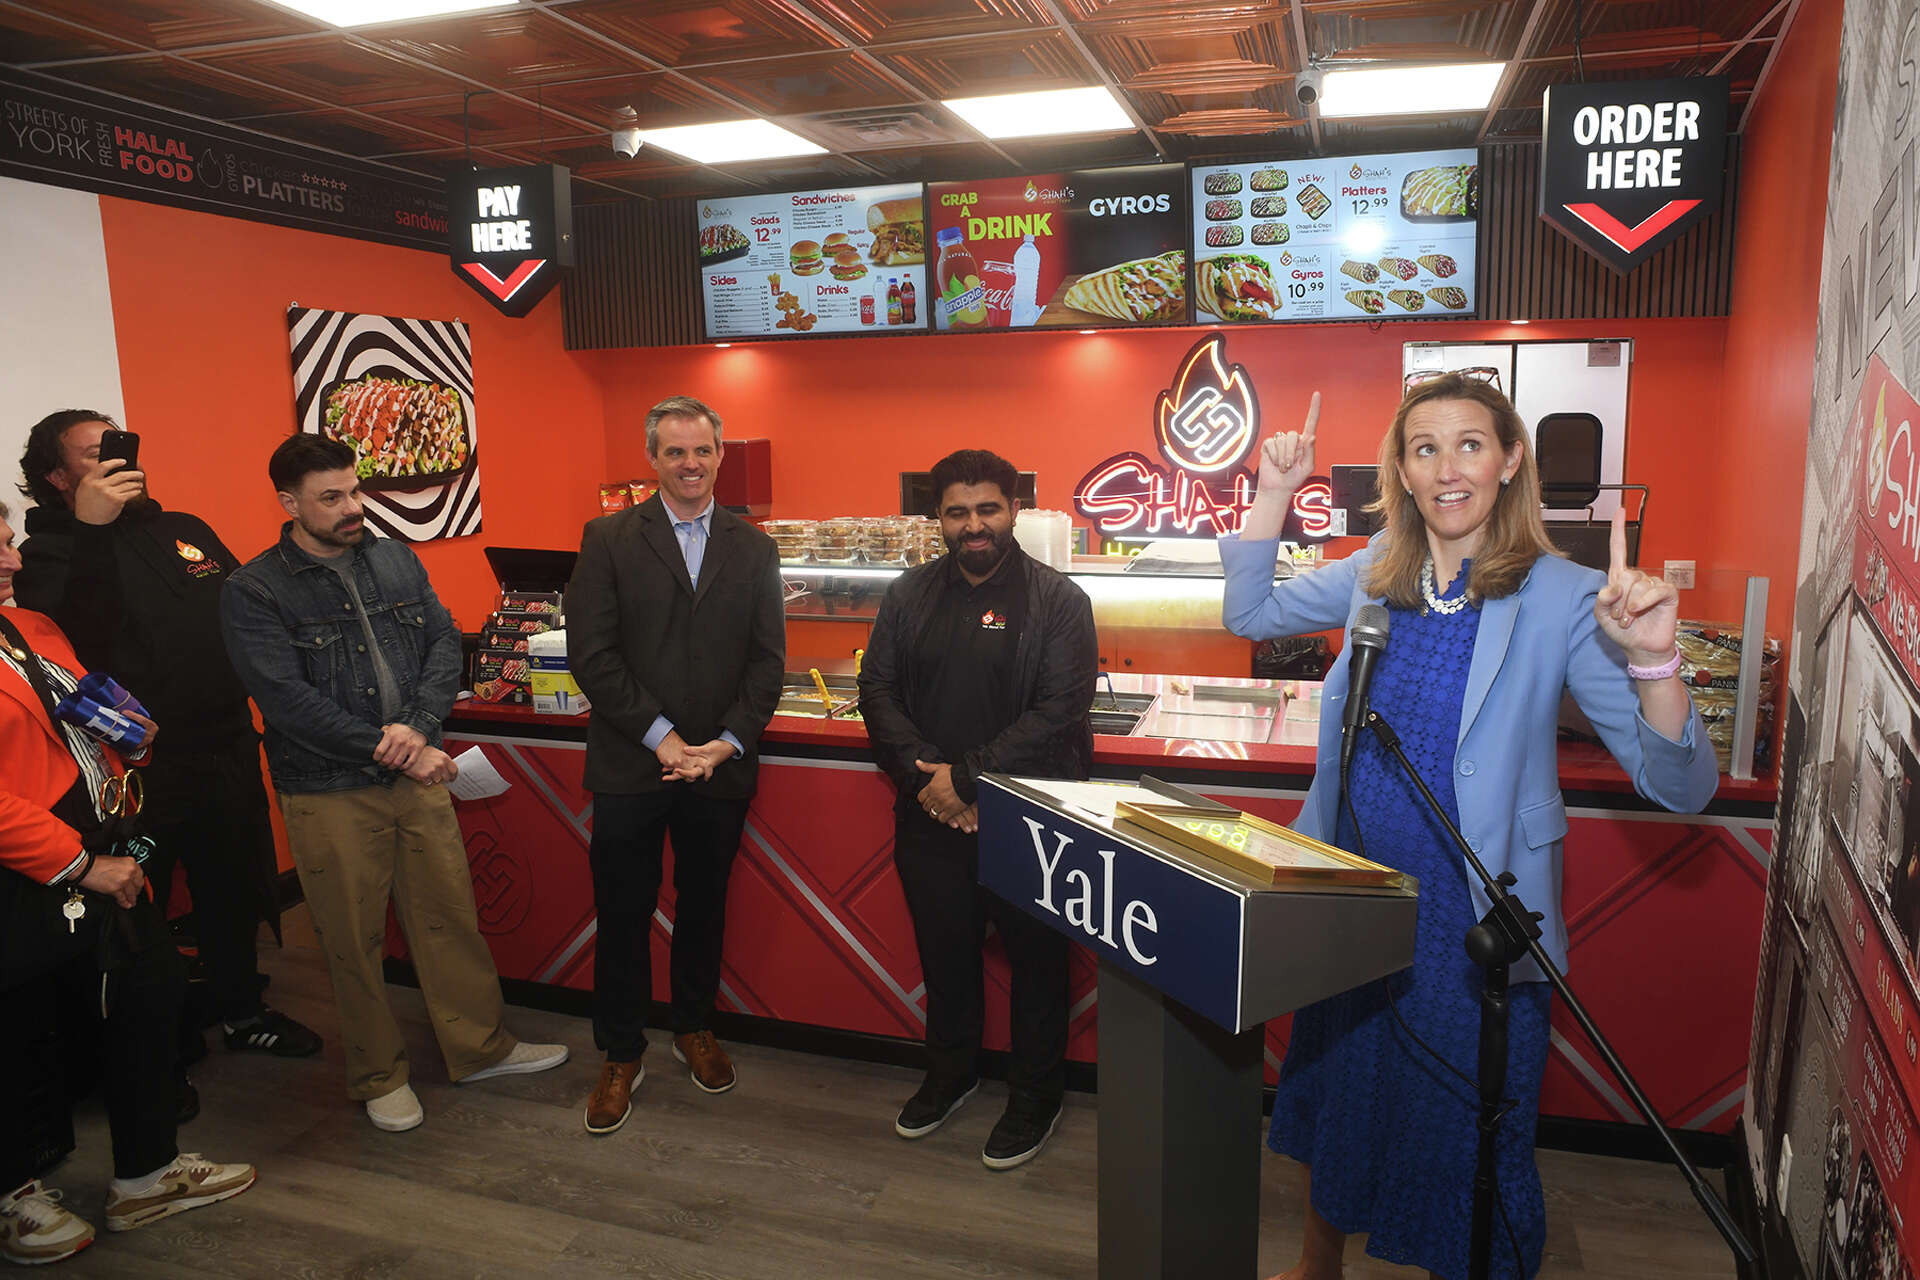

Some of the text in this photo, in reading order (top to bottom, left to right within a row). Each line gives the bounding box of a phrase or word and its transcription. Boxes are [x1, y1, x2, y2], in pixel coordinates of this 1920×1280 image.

[4, 100, 89, 135] STREETS OF
[1573, 101, 1700, 146] ORDER
[9, 122, 94, 163] YORK
[96, 122, 113, 167] FRESH
[114, 126, 193, 161] HALAL
[120, 150, 193, 182] FOOD
[225, 153, 239, 192] GYROS
[1586, 148, 1683, 190] HERE
[242, 175, 345, 212] PLATTERS
[477, 185, 521, 218] PAY
[792, 193, 856, 206] Sandwiches
[941, 192, 978, 206] GRAB
[1089, 194, 1171, 217] GYROS
[1342, 185, 1387, 197] Platters
[1352, 197, 1388, 215] 12.99
[750, 216, 780, 226] Salads
[960, 205, 971, 218] A
[968, 212, 1053, 241] DRINK
[471, 220, 532, 253] HERE
[755, 227, 782, 243] 12.99
[710, 275, 737, 286] Sides
[816, 285, 849, 295] Drinks
[1288, 281, 1324, 298] 10.99
[1291, 269, 1324, 281] Gyros
[1081, 456, 1331, 538] SHAHS
[1022, 816, 1158, 966] Yale
